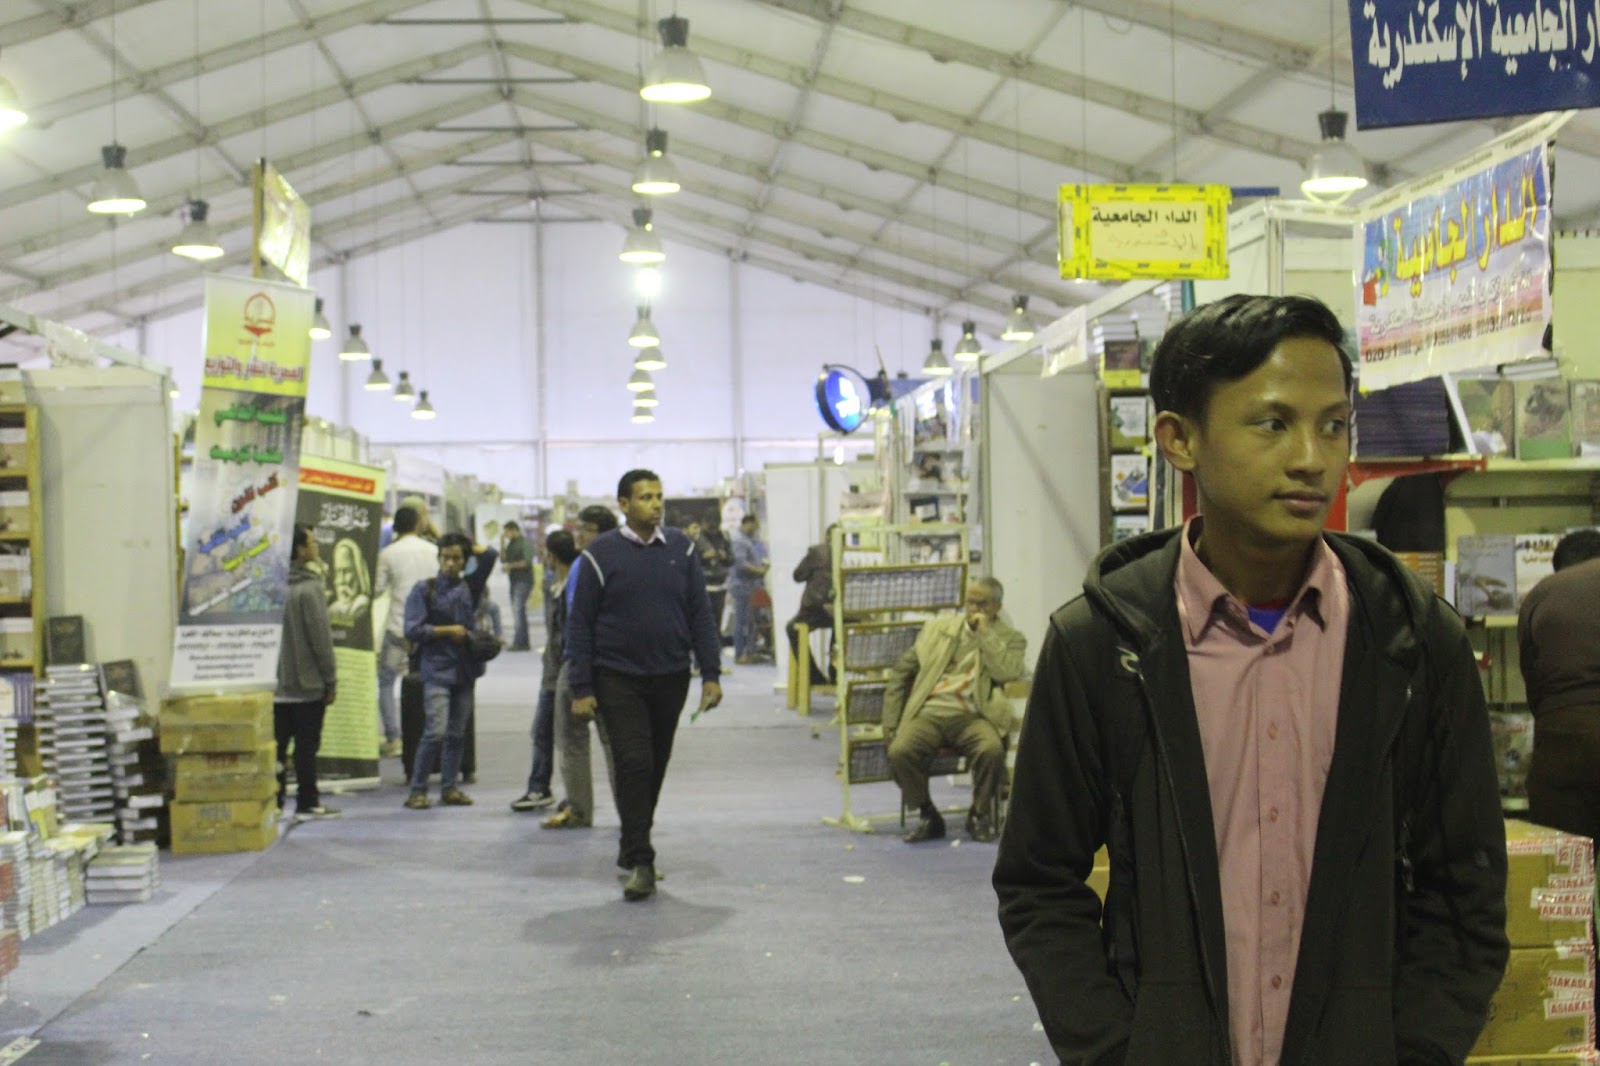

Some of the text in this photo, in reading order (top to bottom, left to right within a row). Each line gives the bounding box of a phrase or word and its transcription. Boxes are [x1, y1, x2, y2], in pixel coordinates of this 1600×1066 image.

[1363, 0, 1483, 90] الإسكندرية
[1486, 0, 1578, 76] الجامعية
[1092, 205, 1159, 228] الجامعية
[1478, 166, 1538, 272] الدار
